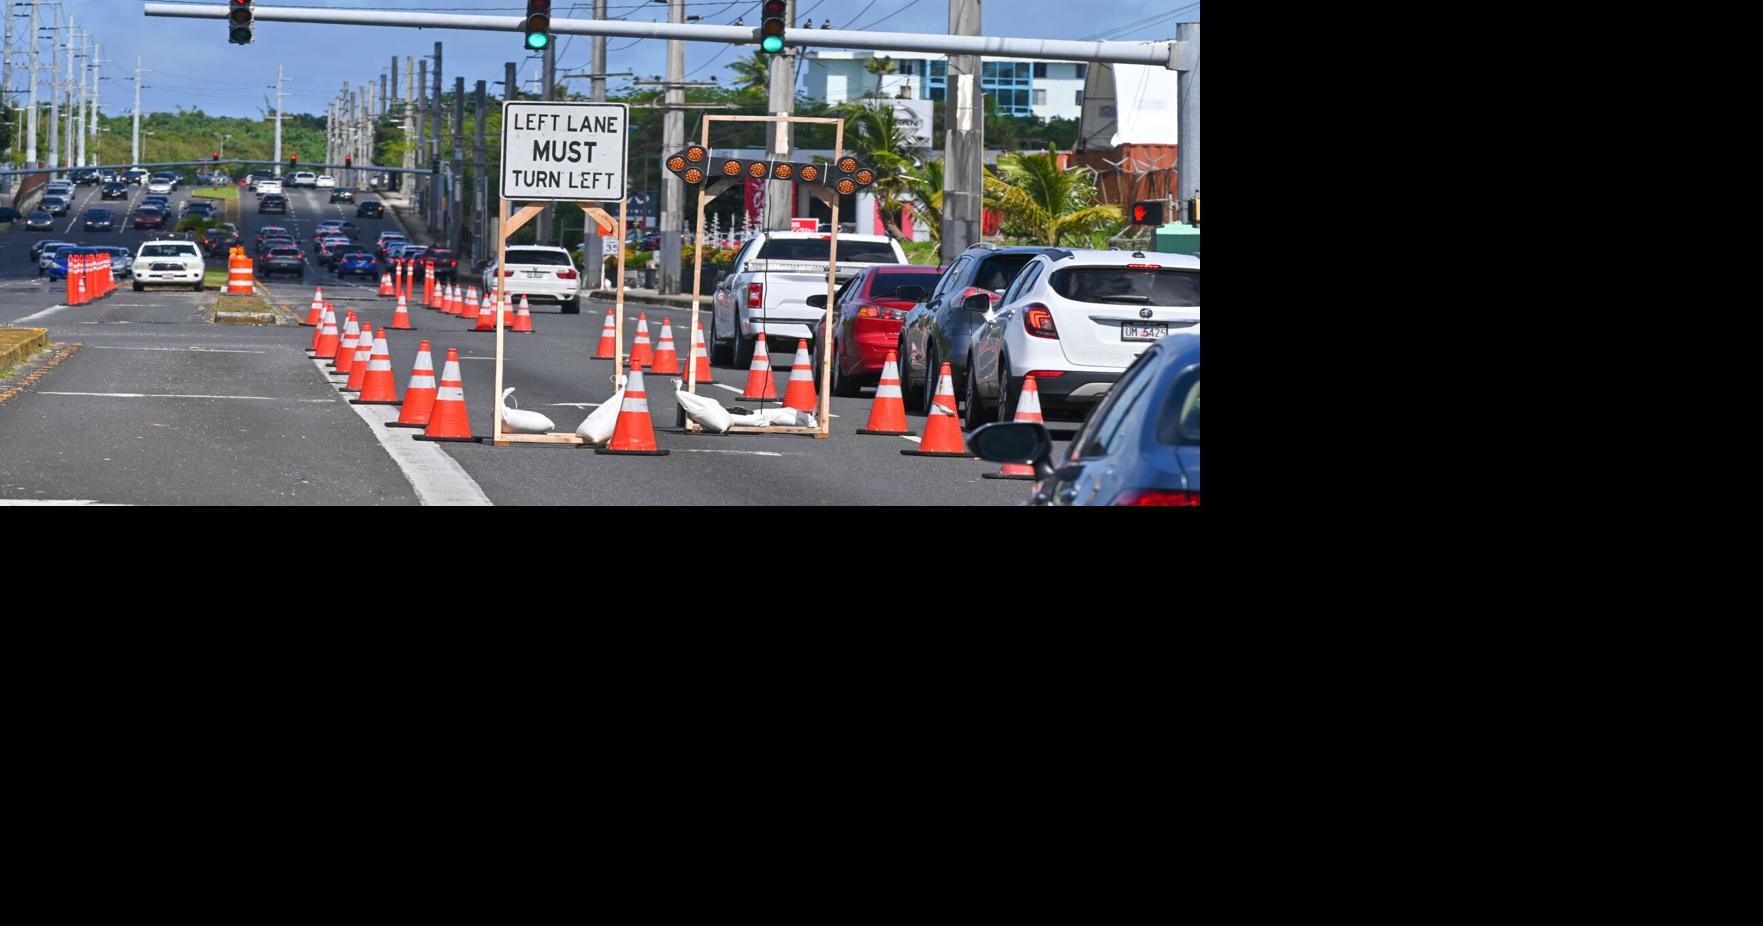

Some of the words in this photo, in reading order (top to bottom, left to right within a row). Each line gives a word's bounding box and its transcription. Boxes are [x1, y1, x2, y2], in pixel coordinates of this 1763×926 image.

[514, 113, 560, 131] LEFT
[567, 115, 618, 133] LANE
[532, 140, 597, 163] MUST
[512, 170, 561, 188] TURN
[569, 171, 615, 190] LEFT
[1125, 327, 1138, 337] UM
